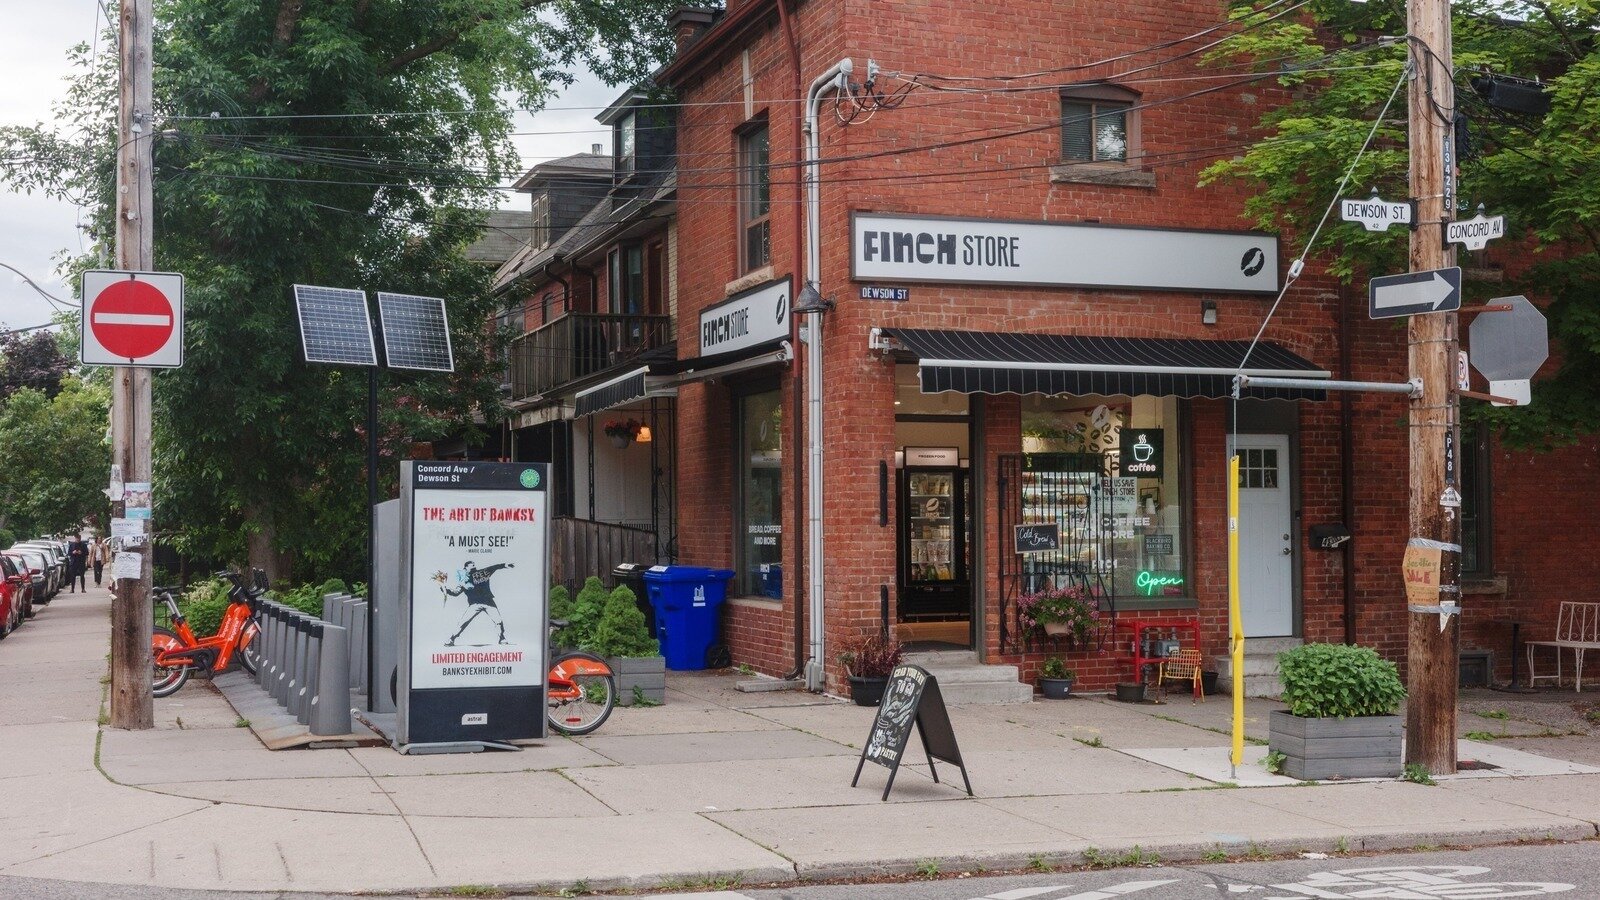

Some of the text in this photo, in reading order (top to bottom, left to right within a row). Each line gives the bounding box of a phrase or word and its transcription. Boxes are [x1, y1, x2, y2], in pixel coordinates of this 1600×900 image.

[1347, 203, 1405, 220] DEWSON ST.
[1449, 222, 1489, 239] CONCORD
[963, 235, 1020, 268] STORE
[862, 287, 907, 300] DEWSON ST
[730, 306, 749, 340] STORE
[417, 464, 451, 473] Concord
[453, 465, 468, 474] Ave
[1128, 463, 1157, 472] coffee
[418, 474, 460, 482] Dewson St
[1120, 488, 1135, 496] STORE
[423, 507, 535, 522] THE ART OF BANKSY
[1101, 517, 1151, 527] COFFEE
[458, 535, 485, 547] MUST
[1137, 571, 1184, 596] Open
[432, 651, 523, 664] LIMITED ENGAGEMENT
[442, 666, 512, 676] BANKSYEXHIBIT.COM
